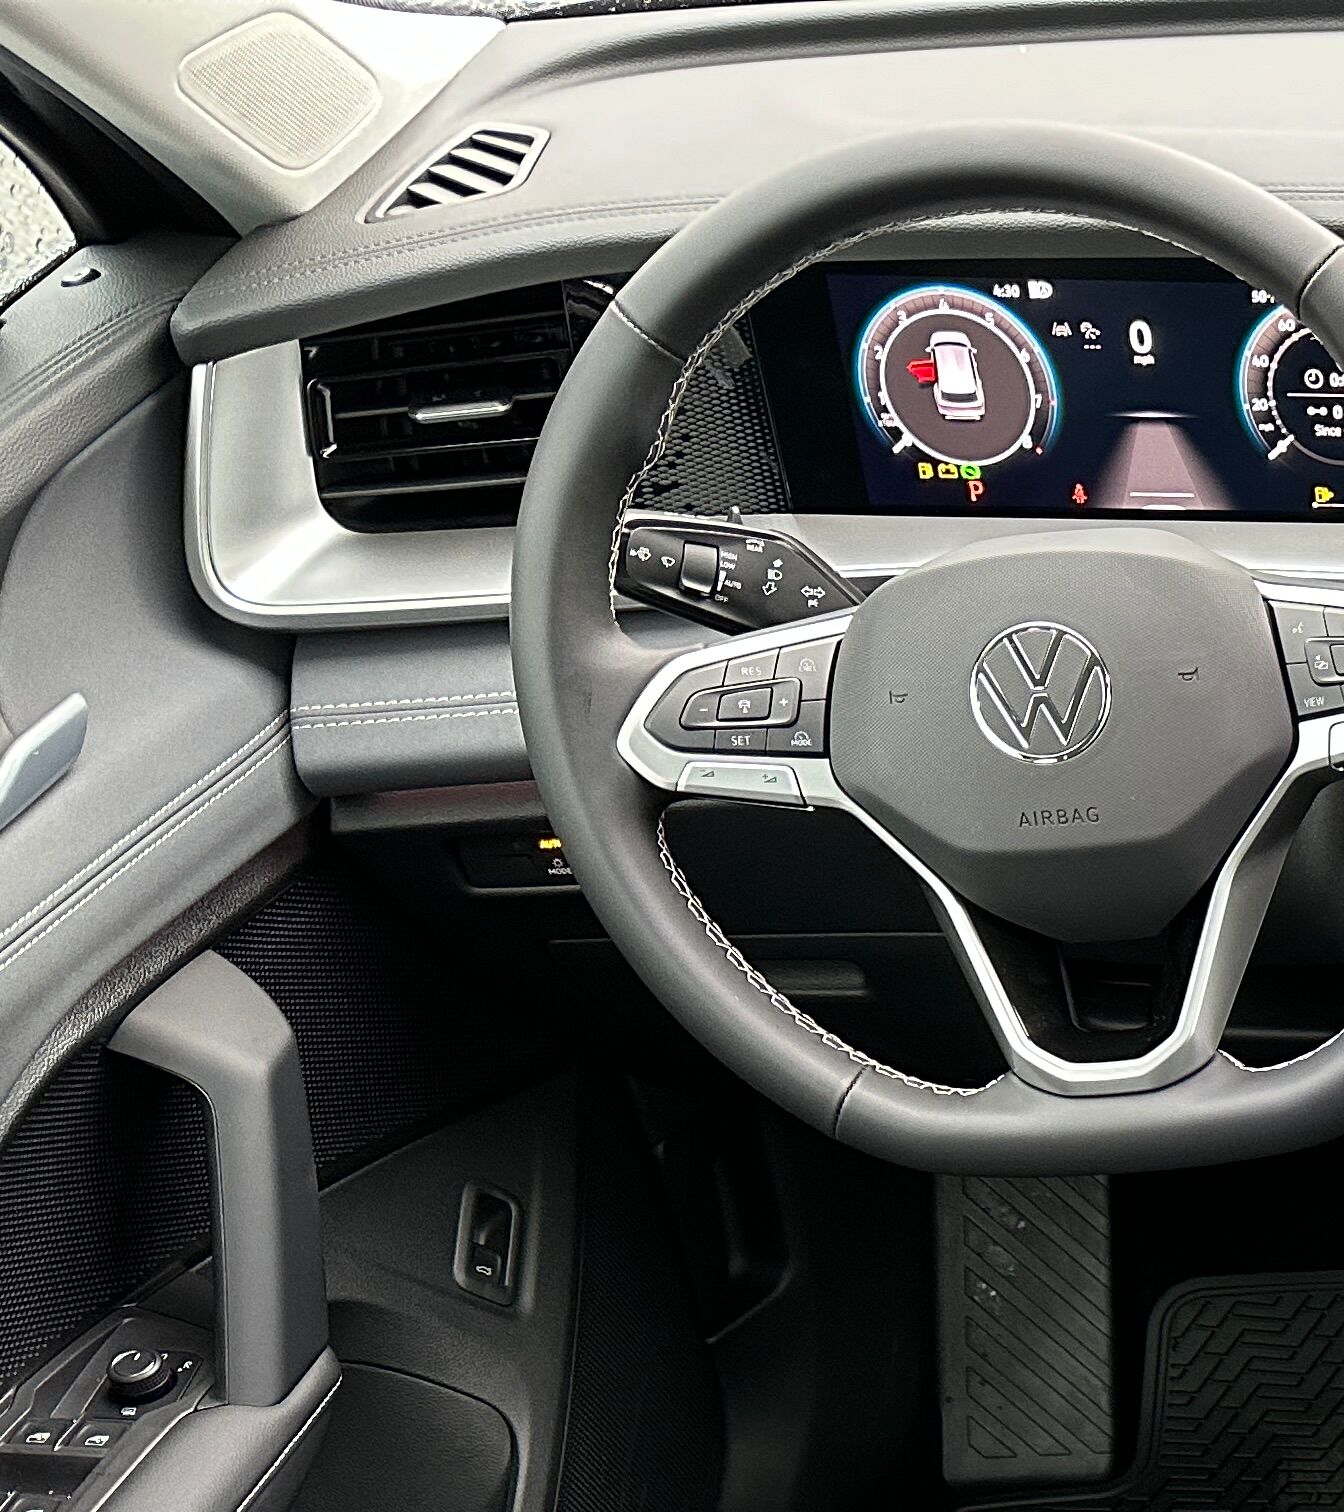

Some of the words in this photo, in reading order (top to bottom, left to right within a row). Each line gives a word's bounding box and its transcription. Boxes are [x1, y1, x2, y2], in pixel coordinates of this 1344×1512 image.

[1278, 319, 1296, 332] 60
[1129, 320, 1153, 353] 0
[1252, 398, 1269, 412] 20
[1332, 405, 1344, 420] 0
[1313, 424, 1342, 438] Since
[966, 480, 985, 501] P
[740, 666, 762, 676] RES
[1303, 696, 1325, 708] VIEW
[731, 735, 751, 746] SET
[1019, 806, 1100, 828] AIRBAG
